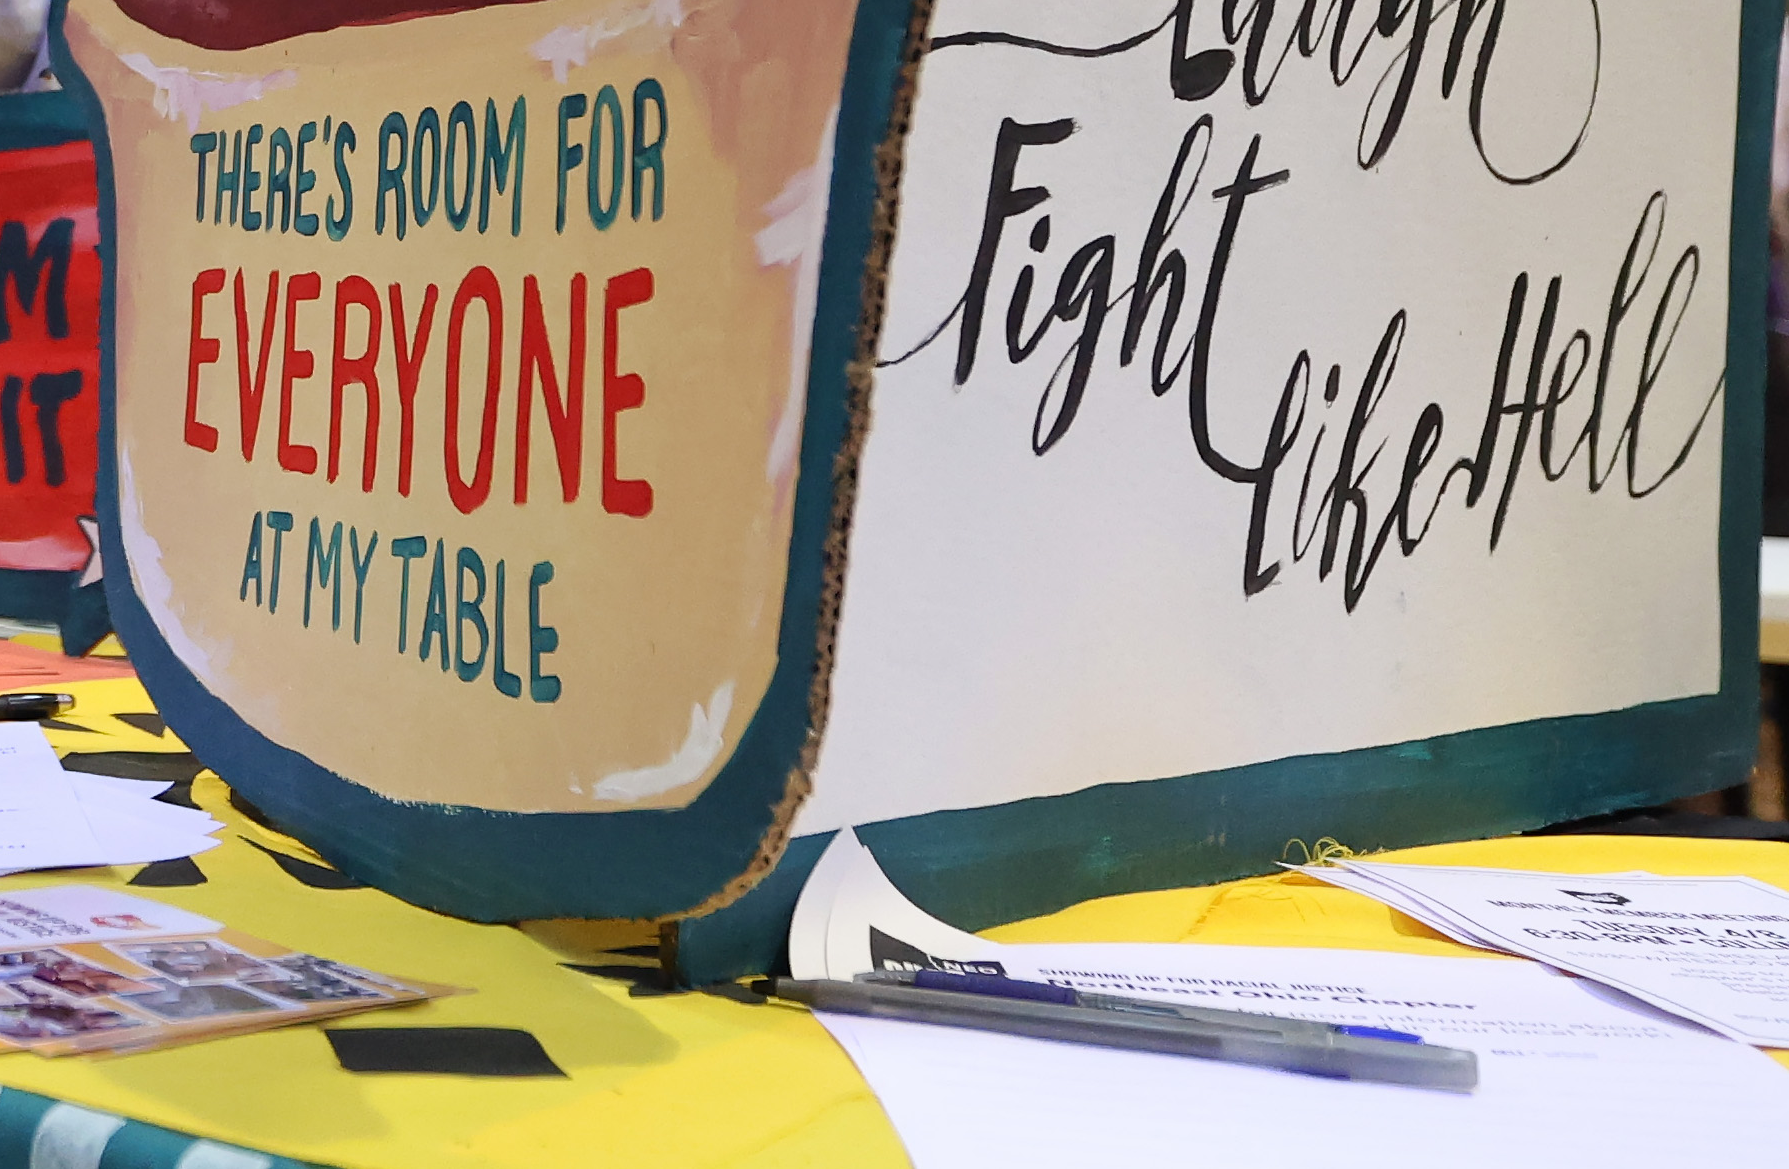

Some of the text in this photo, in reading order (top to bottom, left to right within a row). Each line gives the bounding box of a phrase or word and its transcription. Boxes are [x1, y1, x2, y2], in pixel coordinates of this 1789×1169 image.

[190, 78, 669, 241] THERE'S ROOM FOR
[956, 115, 1289, 480] Fight
[1466, 191, 1702, 552] Hell
[0, 369, 83, 488] IT
[184, 266, 655, 519] EVERYONE
[240, 511, 562, 704] AT MY TABLE
[1038, 968, 1129, 981] SHOWING
[1166, 977, 1206, 985] FOR
[1211, 979, 1281, 989] RACIAL
[1289, 984, 1367, 994] JUSTICE
[1046, 978, 1480, 1010] Northeast Ohio Chapter
